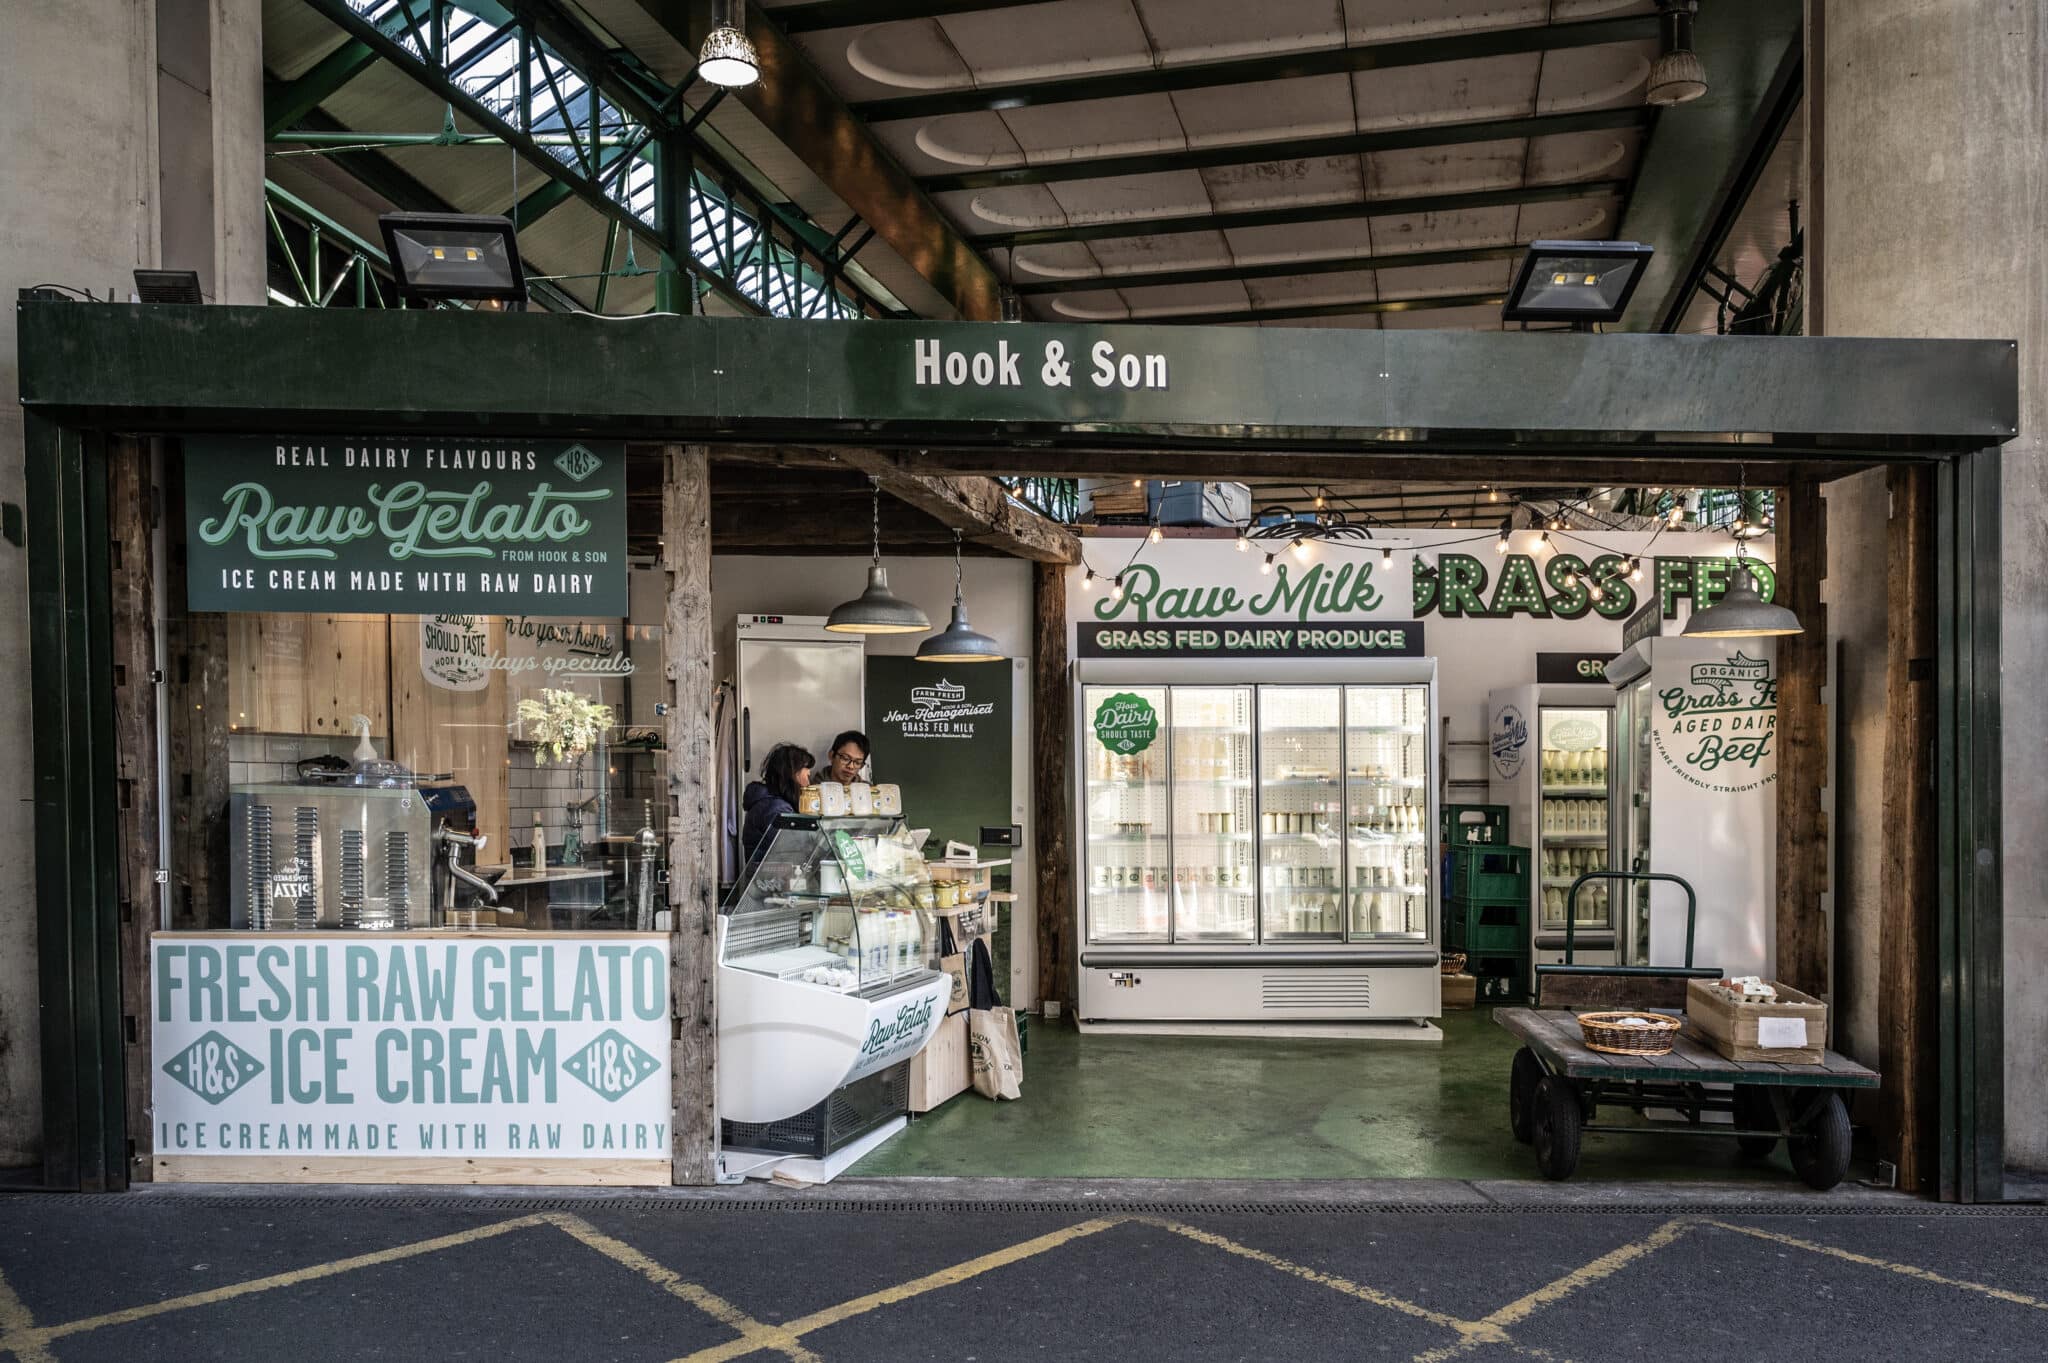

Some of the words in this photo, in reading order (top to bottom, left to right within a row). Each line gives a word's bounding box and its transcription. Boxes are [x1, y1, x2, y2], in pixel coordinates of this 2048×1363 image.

[915, 339, 1021, 385] Hook
[1041, 340, 1072, 387] &
[1091, 340, 1168, 388] Son
[275, 446, 329, 466] REAL
[345, 448, 410, 468] DAIRY
[426, 449, 537, 470] FLAVOURS
[566, 447, 590, 475] H&S
[199, 482, 376, 559] Raw
[367, 480, 613, 560] Gelato
[502, 550, 534, 562] FROM
[538, 551, 567, 562] HOOK
[572, 552, 581, 562] &
[585, 552, 607, 562] SON
[222, 569, 255, 589] ICE
[269, 570, 336, 590] CREAM
[350, 571, 404, 591] MADE
[418, 572, 466, 592] WITH
[480, 573, 520, 592] RAW
[533, 574, 593, 594] DAIRY
[1094, 564, 1244, 622] Raw
[1250, 562, 1384, 622] Milk
[425, 624, 460, 653] SHOULD
[462, 633, 487, 658] TASTE
[574, 621, 612, 651] home
[1096, 630, 1170, 650] GRASS
[1176, 631, 1220, 650] FED
[1225, 631, 1292, 650] DAIRY
[1298, 631, 1406, 650] PRODUCE
[540, 650, 634, 678] specials
[1700, 667, 1760, 677] ORGANIC
[882, 702, 994, 722] Non-Homogenised
[1114, 701, 1139, 712] How
[1658, 687, 1743, 719] Grass
[902, 722, 929, 732] GRASS
[934, 723, 949, 732] FED
[953, 723, 975, 733] MILK
[1097, 708, 1154, 729] Dairy
[1672, 718, 1722, 734] AGED
[1101, 730, 1128, 739] SHOULD
[1131, 730, 1151, 739] TASTE
[1653, 729, 1673, 766] WELFARE
[1671, 764, 1711, 790] FRIENDLY
[1713, 782, 1759, 793] STRAIGHT
[1686, 730, 1774, 771] Beef
[157, 945, 330, 1022] FRESH
[345, 945, 458, 1022] RAW
[472, 945, 666, 1022] GELATO
[861, 1018, 896, 1055] Raw
[893, 994, 938, 1044] Gelato
[188, 1041, 240, 1095] H&S
[270, 1028, 354, 1105] ICE
[376, 1028, 558, 1104] CREAM
[587, 1038, 637, 1092] H&S
[162, 1122, 207, 1149] ICE
[219, 1123, 313, 1149] CREAM
[324, 1124, 399, 1150] MADE
[419, 1123, 487, 1150] WITH
[508, 1123, 562, 1149] RAW
[583, 1123, 665, 1149] DAIRY
